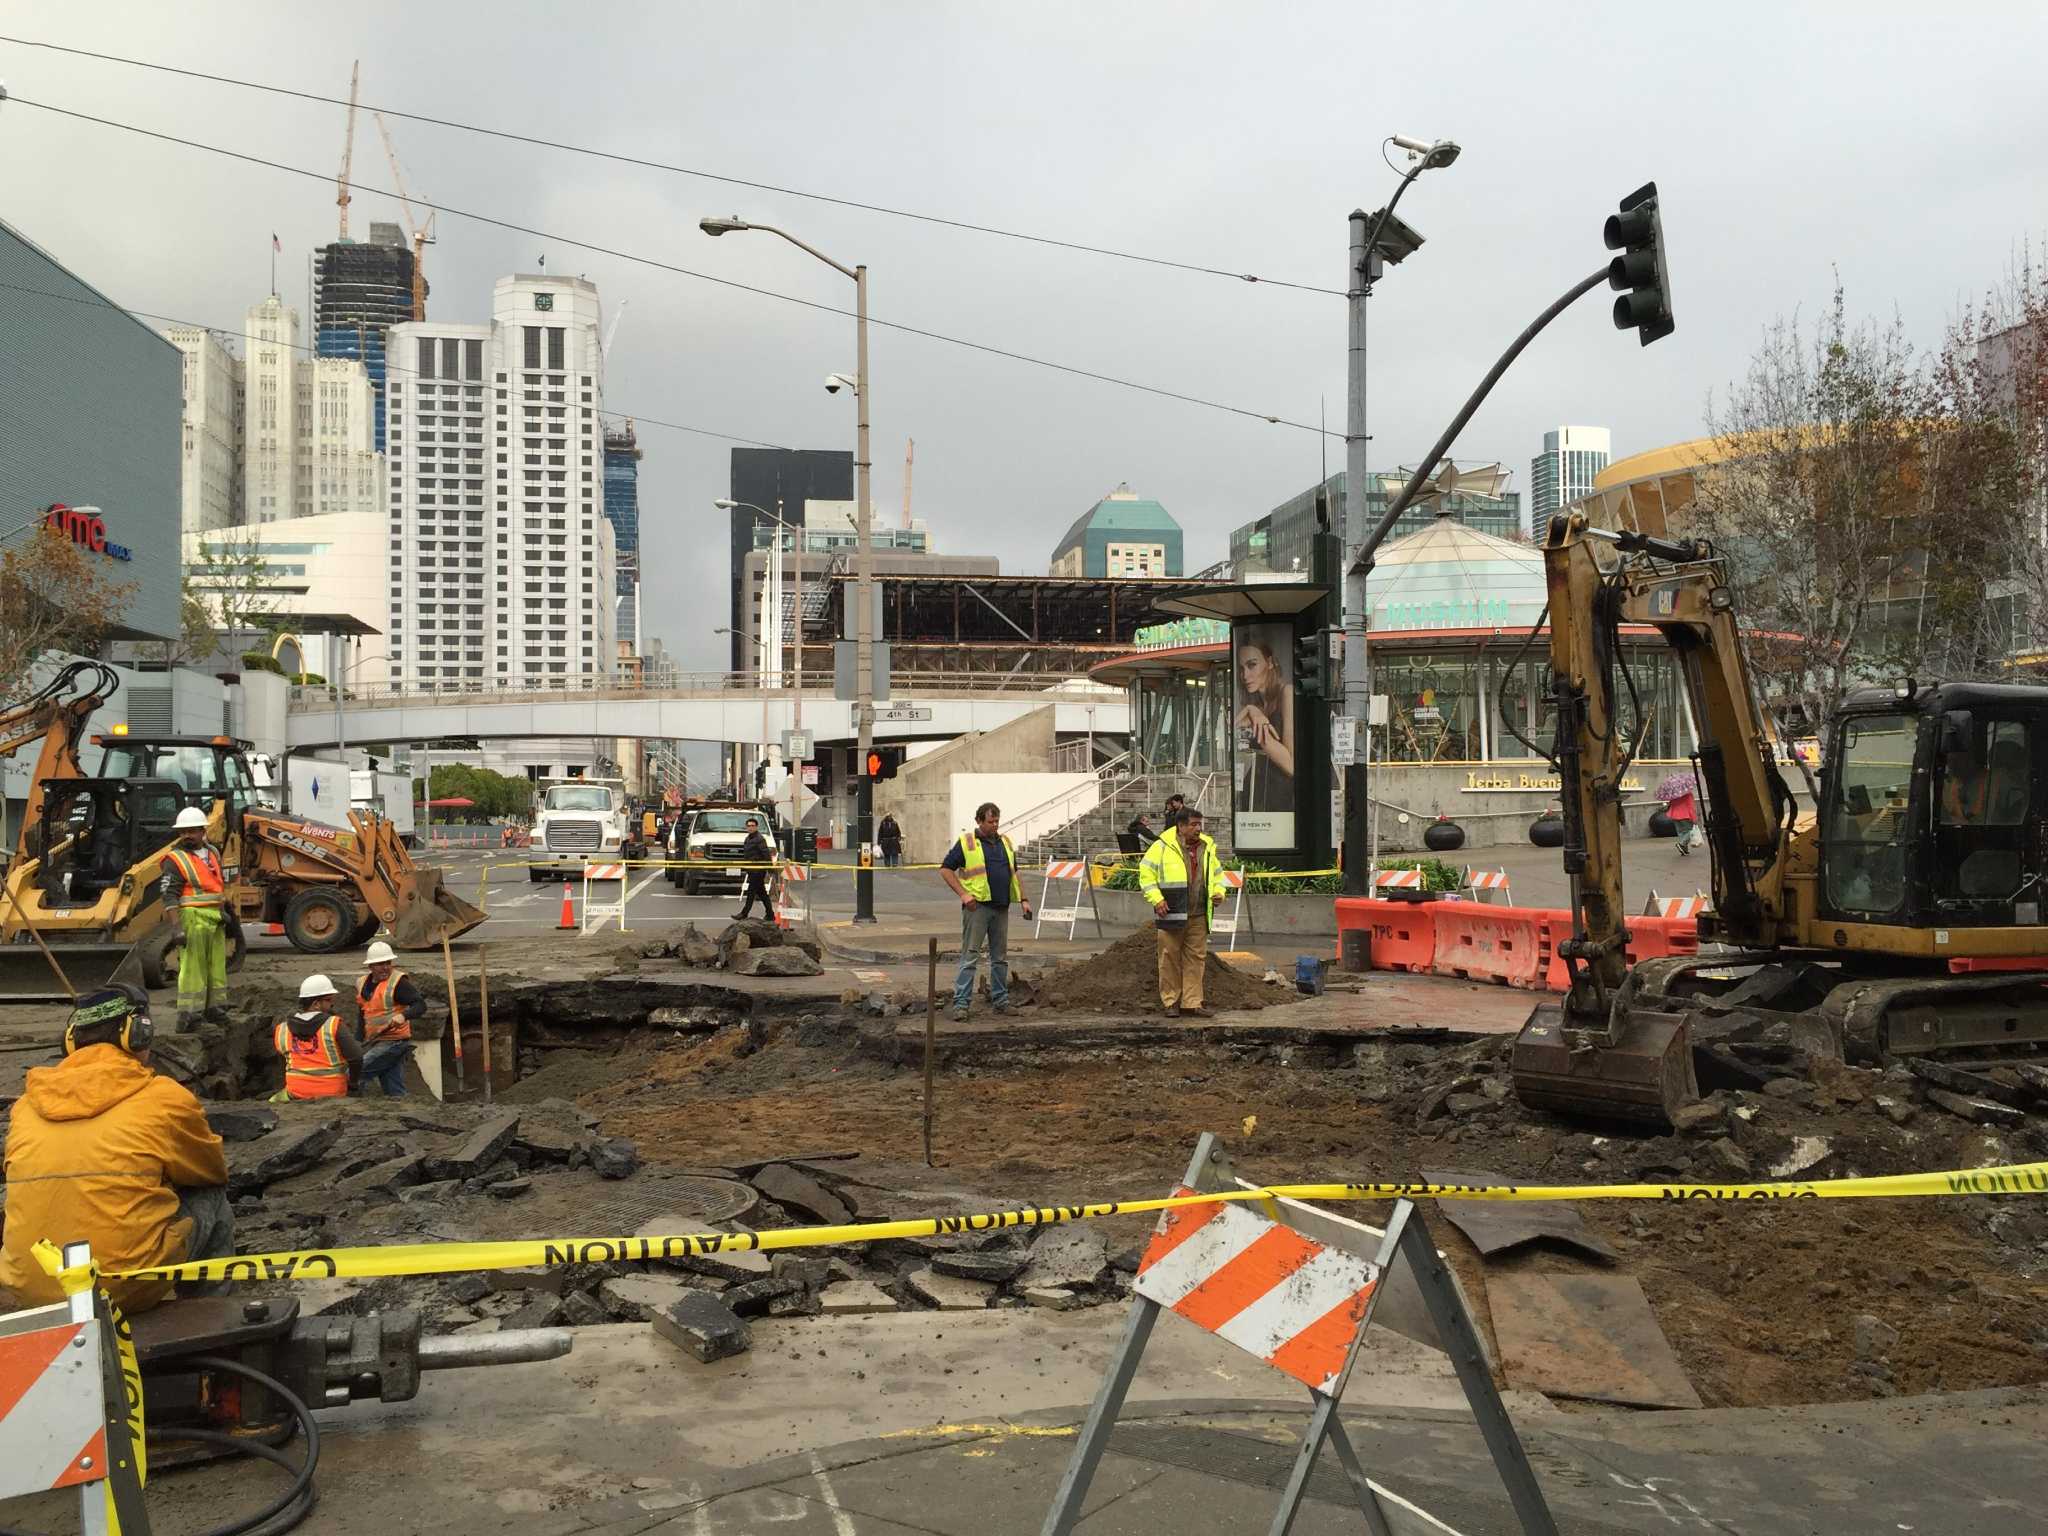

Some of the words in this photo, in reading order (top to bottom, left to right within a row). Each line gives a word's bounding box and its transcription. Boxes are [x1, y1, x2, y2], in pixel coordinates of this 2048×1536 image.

[1388, 600, 1510, 624] MUSEUM
[1659, 590, 1672, 614] CAT
[886, 711, 902, 719] 4th
[278, 831, 328, 859] CASE
[1372, 924, 1393, 940] TPC
